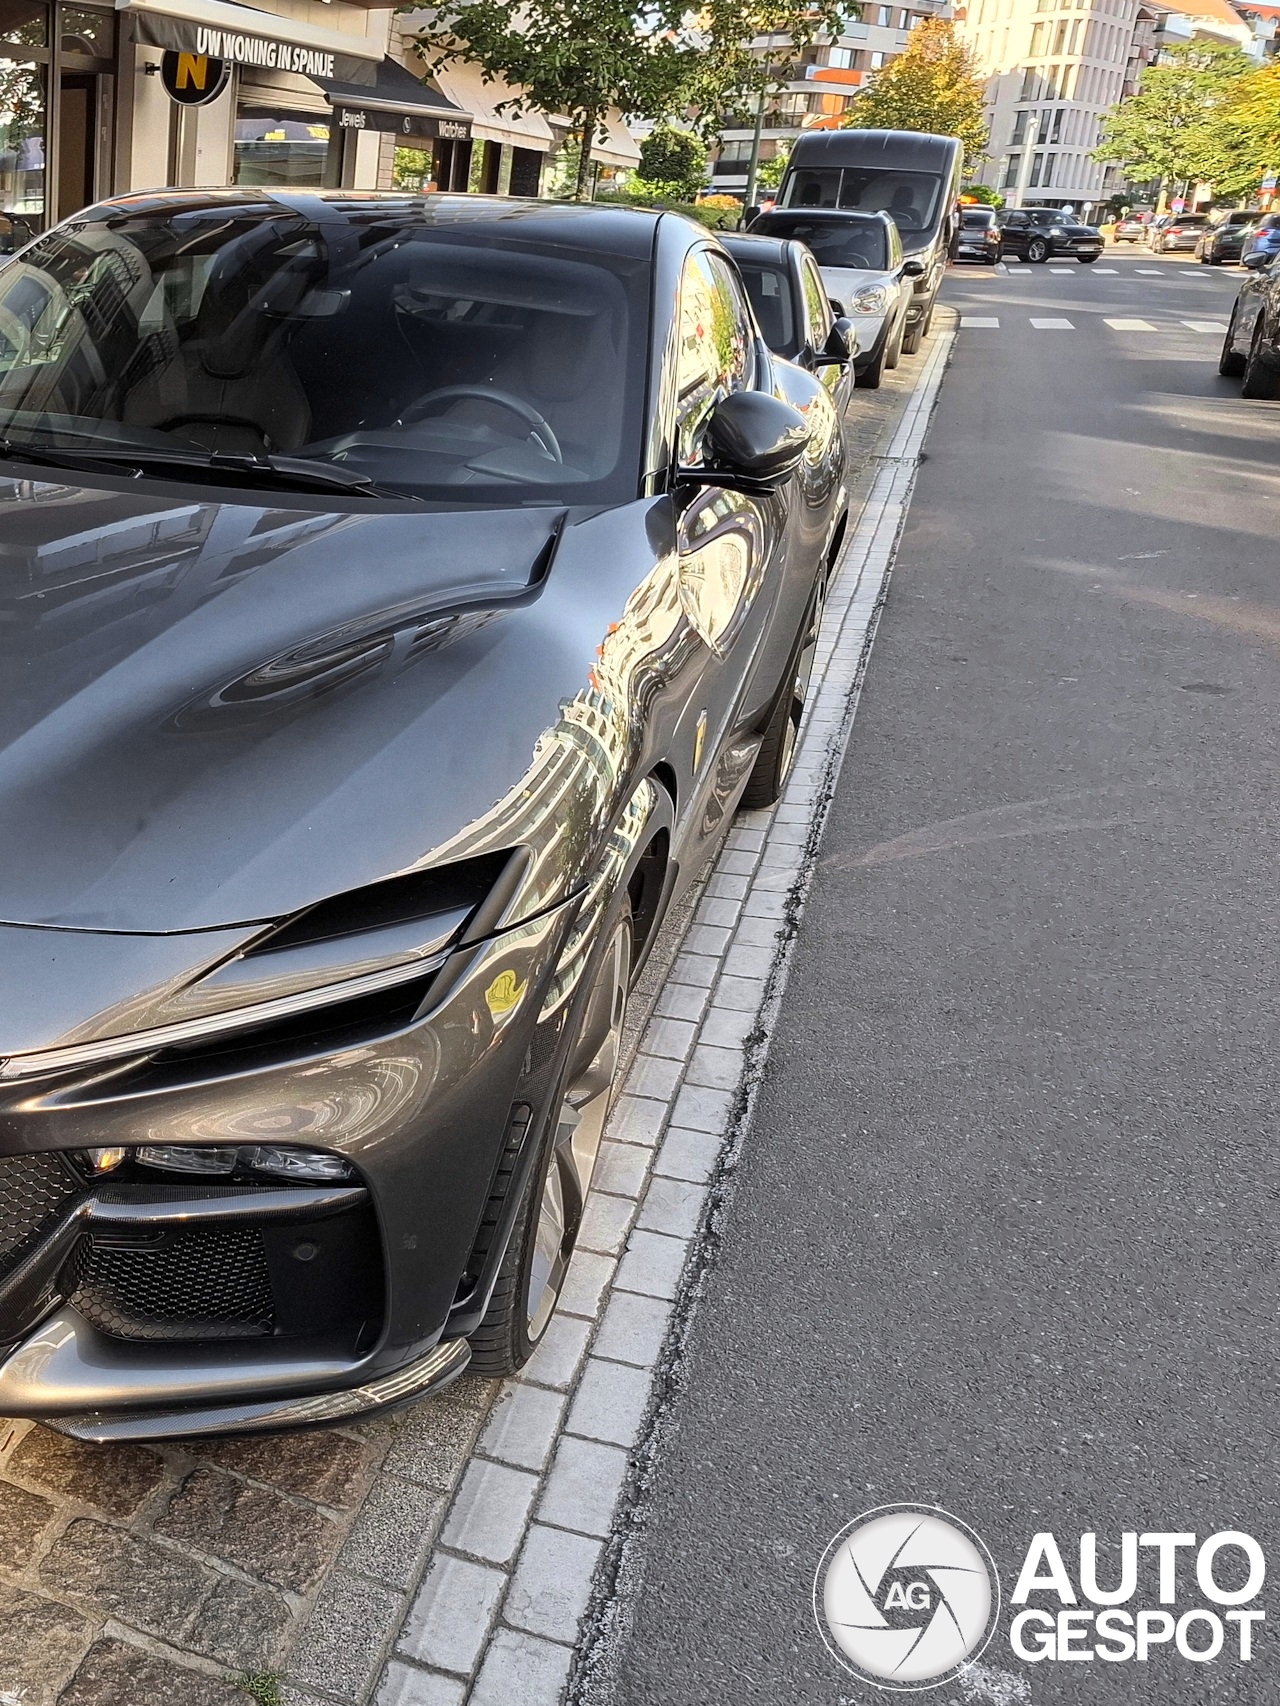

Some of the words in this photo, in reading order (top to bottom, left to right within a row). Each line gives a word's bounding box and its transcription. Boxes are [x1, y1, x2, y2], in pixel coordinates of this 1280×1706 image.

[196, 26, 221, 57] UW
[221, 32, 277, 68] WONING
[277, 44, 292, 71] IN
[292, 47, 335, 78] SPANJE
[175, 52, 208, 91] N
[338, 108, 366, 129] Jewels
[438, 120, 467, 139] Watches
